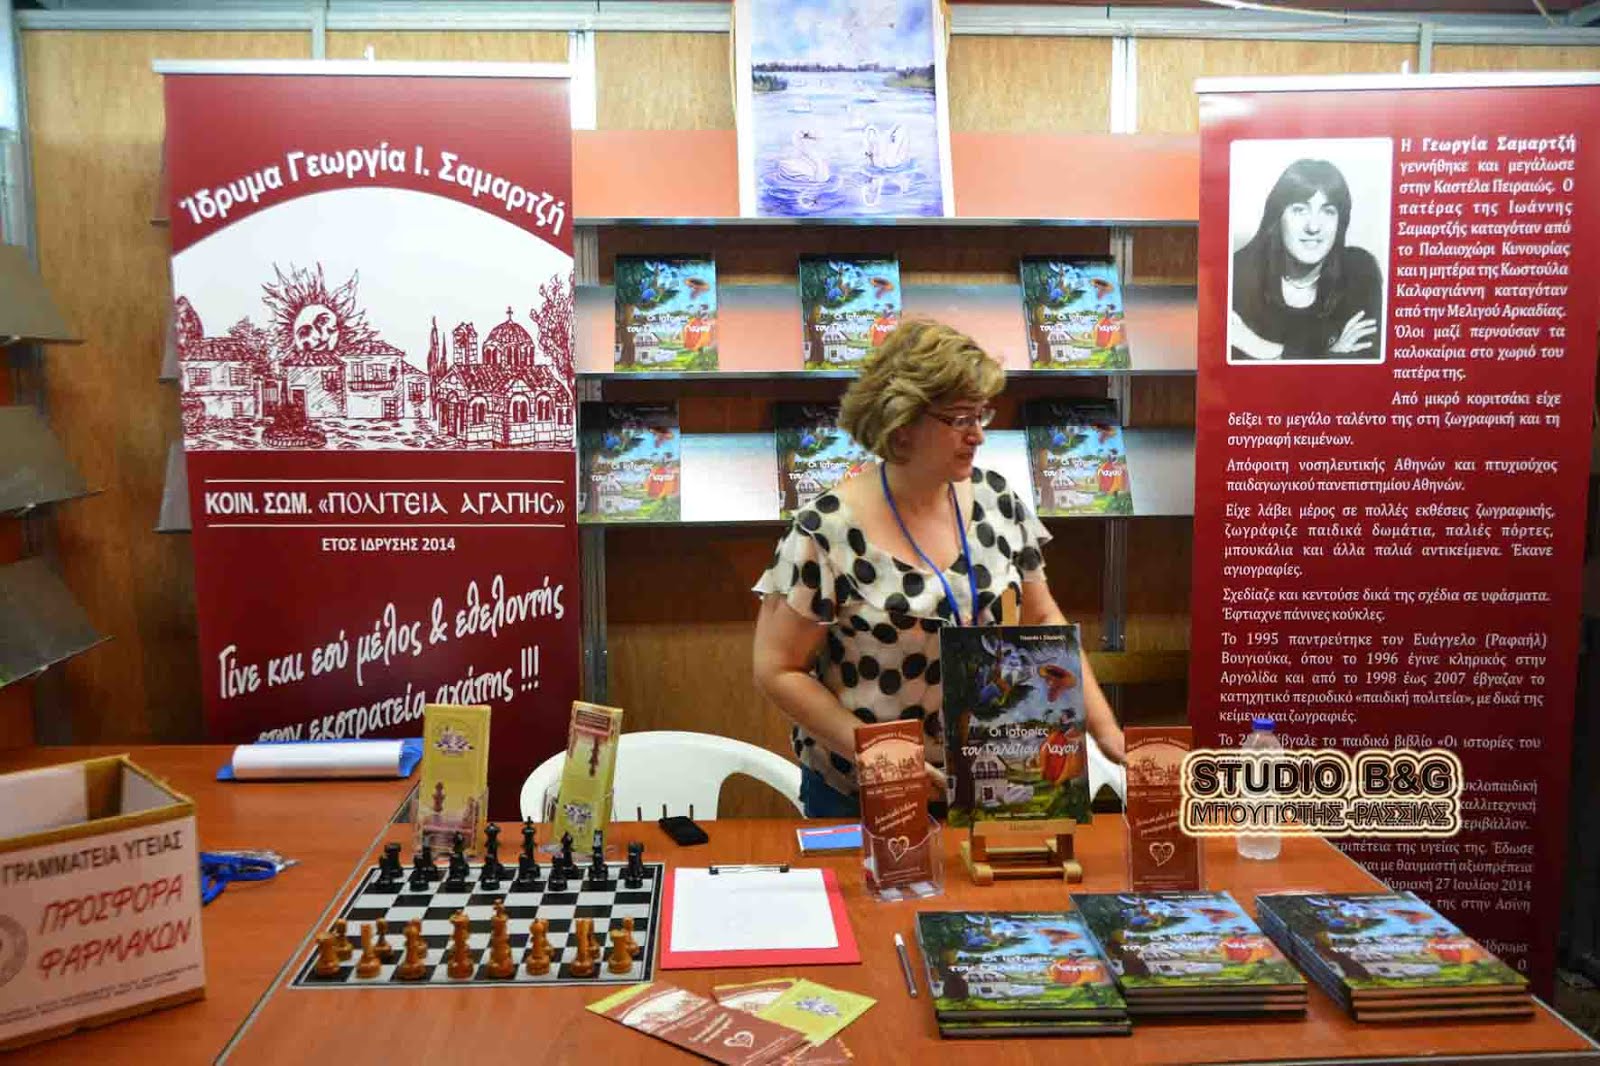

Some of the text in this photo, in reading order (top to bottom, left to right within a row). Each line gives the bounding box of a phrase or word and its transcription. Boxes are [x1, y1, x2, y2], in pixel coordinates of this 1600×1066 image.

[1402, 134, 1576, 154] Η Γεωργία Σαμαρτζή
[1401, 158, 1574, 174] γεννήθηκε και μεγάλωσε
[181, 141, 564, 236] Ίδρυμα Γεωργία Ι. Σαμαρτζή
[1400, 178, 1574, 196] στην Καστέλα Πειραιώς. Ο
[1399, 200, 1572, 216] πατέρας της Ιωάννης
[1399, 220, 1571, 238] Σαμαρτζής καταγόταν από
[1398, 241, 1570, 258] το Παλαιοχώρι Κυνουρίας
[1430, 262, 1568, 278] μητέρα Κωστούλα
[1397, 284, 1568, 298] Καλφαγιάννη καταγόταν
[1395, 304, 1565, 320] από Μελιγού Αρκαδίας.
[1395, 324, 1565, 340] Όλοι μαζί περνούσαν τα
[1394, 344, 1564, 360] καλοκαίρια στο χωριό του
[1394, 366, 1440, 382] πατέρα
[1392, 390, 1561, 408] Από μικρό κοριτσάκι είχε
[1228, 412, 1515, 428] δείξει το μεγάλο ταλέντο στη ζωγραφική
[1228, 436, 1353, 448] συγγραφή κειμένων.
[1228, 458, 1557, 474] Απόφοιτη νοσηλευτικής Αθηνών και πτυχιούχος
[1227, 478, 1464, 494] παιδαγωγικού πανεπιστημίου Αθηνών.
[206, 492, 258, 514] ΚΟΙΝ.
[264, 492, 312, 514] ΣΩΜ.
[1226, 502, 1554, 520] Είχε λάβει μέρος πολλές εκθέσεις ζωγραφικής,
[1225, 522, 1553, 538] ζωγράφιζε παιδικά δωμάτια, παλιές πόρτες,
[322, 538, 455, 551] ΕΤΟΣ ΙΔΡΥΣΗΣ 2014
[1225, 542, 1552, 556] μπουκάλια και άλλα παλιά αντικείμενα. Έκανε
[1224, 566, 1302, 578] αγιογραφίες.
[1224, 588, 1549, 604] Σχεδίαζε και κεντούσε δικά της σχέδια υφάσματα.
[1222, 608, 1384, 622] Έφτιαχνε πάνινες κούκλες.
[219, 574, 564, 698] Γίνε και εσύ μέλος & εθελοντής
[1222, 632, 1546, 648] Το 1995 παντρεύτηκε τον Ευάγγελο (Ραφαήλ)
[1222, 652, 1546, 668] Βουγιούκα, όπου 1996 έγινε κληρικός στην
[1221, 670, 1523, 686] Αργολίδα και από 1998 έως 2007 έβγαζαν
[1221, 690, 1474, 706] κατηχητικό περιοδικό «παιδική πολιτεία»,
[1289, 710, 1356, 724] ζωγραφιές.
[2, 829, 184, 884] ΓΡΑΜΜΑΤΕΙΑ ΥΓΕΙΑΣ
[39, 873, 184, 936] ΠΡΟΣΦΟΡΑ
[38, 916, 192, 981] ΦΑΡΜΑΚΩΝ
